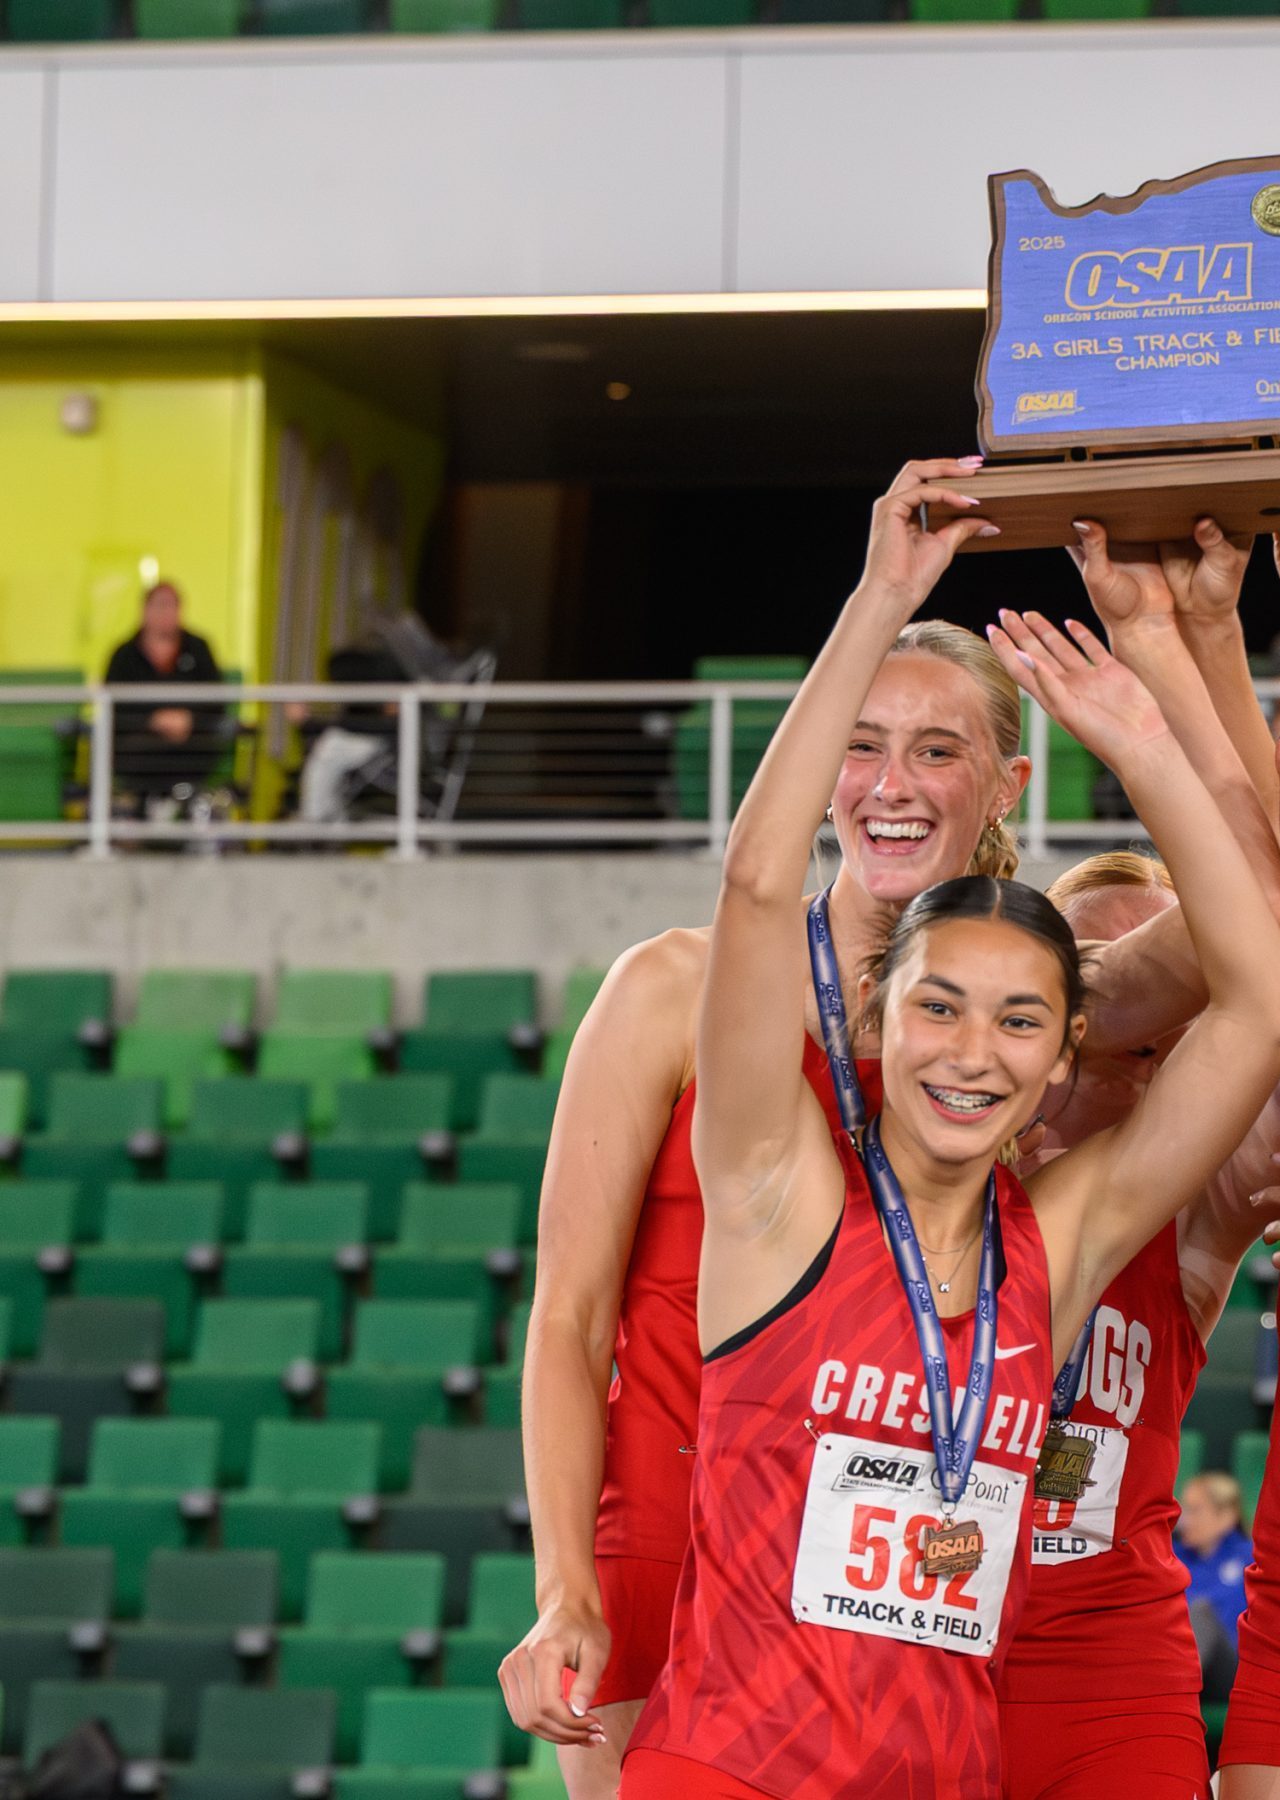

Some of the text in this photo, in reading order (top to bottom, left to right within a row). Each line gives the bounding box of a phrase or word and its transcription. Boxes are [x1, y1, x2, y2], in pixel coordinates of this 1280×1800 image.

[1018, 235, 1066, 251] 2025
[1064, 242, 1253, 311] OSAA
[1043, 312, 1091, 324] OREGON
[1095, 308, 1139, 321] SCHOOL
[1142, 304, 1204, 318] ACTIVITIES
[1011, 342, 1043, 360] 3A
[1053, 337, 1124, 357] GIRLS
[1134, 331, 1215, 352] TRACK
[1226, 330, 1243, 346] &
[1115, 351, 1220, 371] CHAMPION
[1018, 391, 1075, 412] OSAA
[810, 1359, 1046, 1458] CRESELL
[846, 1455, 920, 1487] OSAA
[1049, 1451, 1085, 1477] AA
[931, 1467, 1009, 1504] Point
[927, 1534, 979, 1560] OSAA
[823, 1594, 982, 1641] TRACK & FIELD
